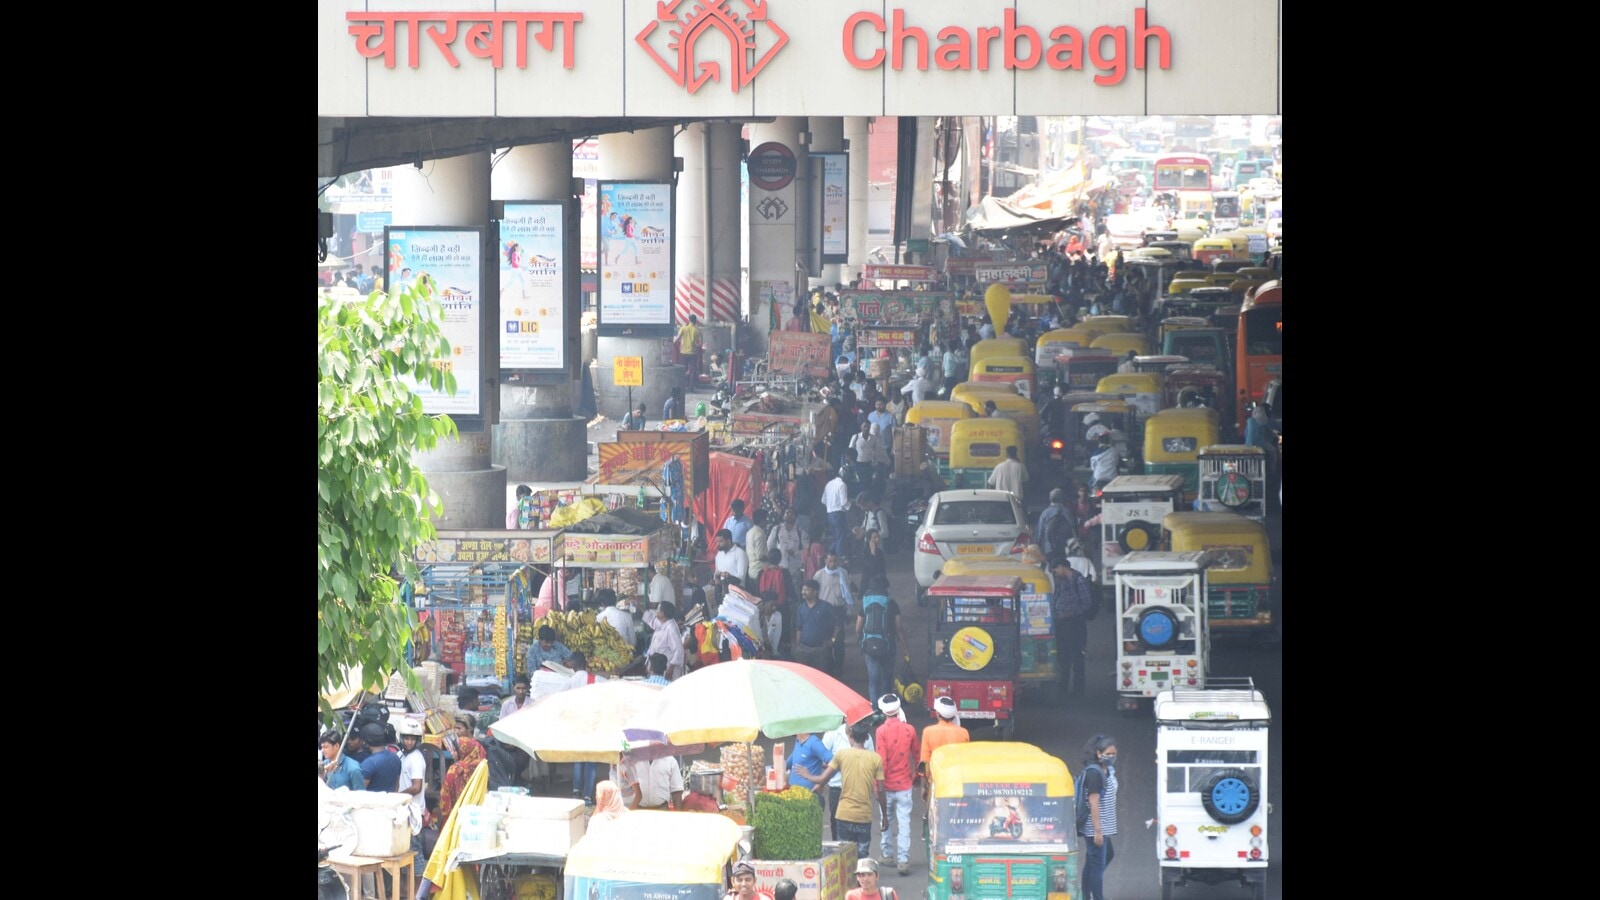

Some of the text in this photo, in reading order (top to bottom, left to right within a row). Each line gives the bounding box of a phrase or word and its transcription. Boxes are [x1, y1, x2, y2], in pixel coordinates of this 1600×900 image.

[345, 11, 584, 69] चारबाग
[841, 7, 1173, 87] Charbagh
[980, 265, 1032, 279] महालक्ष्मी
[634, 283, 649, 293] LIC
[520, 321, 538, 333] LIC
[461, 541, 478, 551] अण्डा
[480, 539, 492, 551] रोल
[563, 539, 643, 551] ण्डे भोजनालय
[457, 551, 475, 561] उबला
[1191, 736, 1236, 745] E-RANGER
[947, 855, 962, 864] CNG
